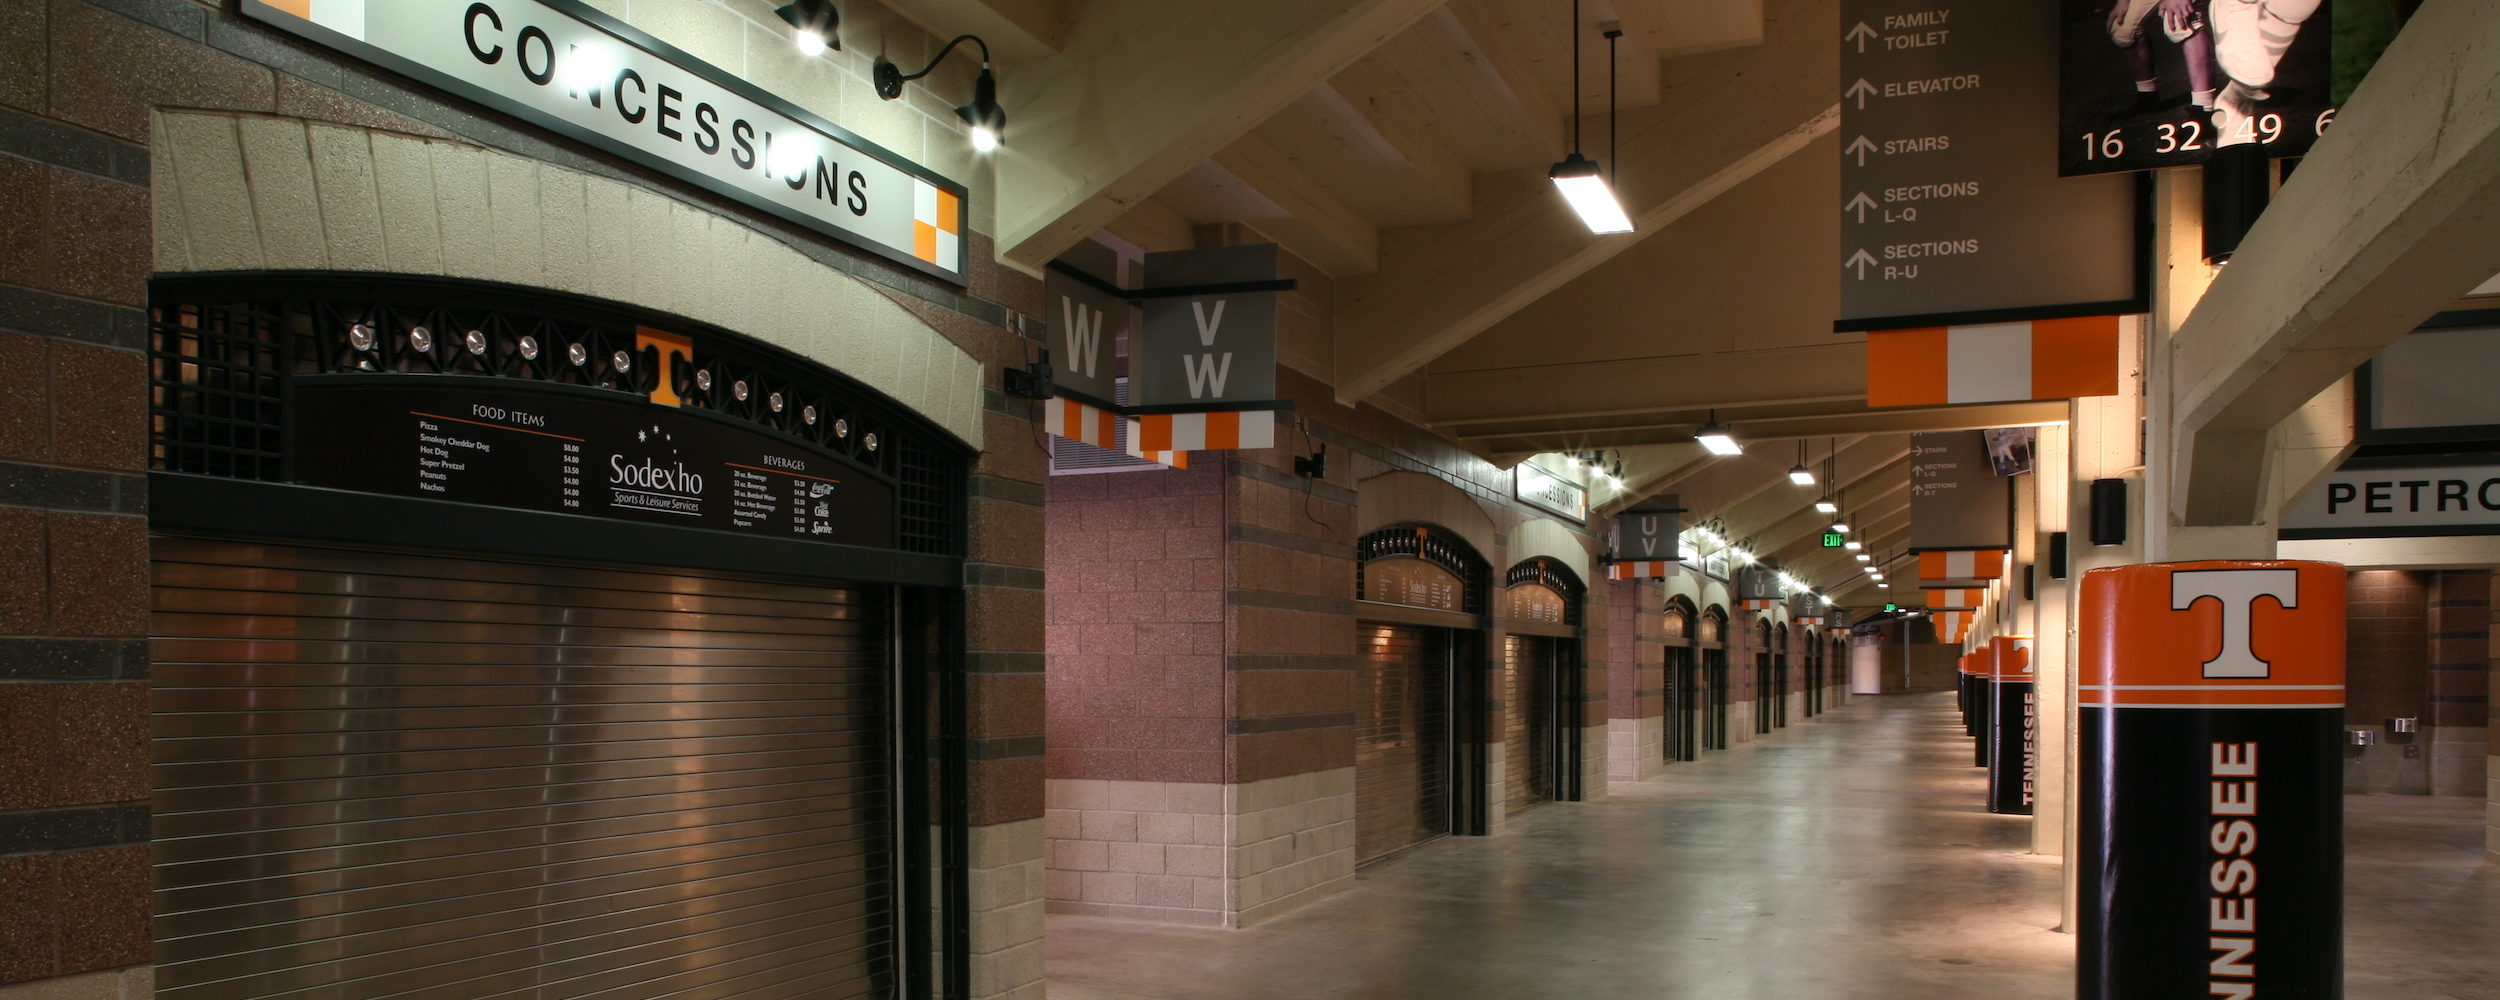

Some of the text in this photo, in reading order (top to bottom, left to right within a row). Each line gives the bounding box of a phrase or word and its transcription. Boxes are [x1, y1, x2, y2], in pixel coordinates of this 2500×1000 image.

[1884, 9, 1949, 30] FAMILY
[1884, 31, 1949, 51] TOILET
[1884, 75, 1980, 97] ELEVATOR
[1884, 135, 1949, 155] STAIRS
[2082, 128, 2124, 160] 16
[2156, 120, 2201, 153] 32
[2233, 113, 2282, 145] 49
[1884, 181, 1979, 202] SECTIONS
[1884, 207, 1917, 223] L-Q
[1884, 239, 1978, 260] SECTIONS
[1884, 265, 1918, 280] R-U
[1192, 300, 1226, 346] V
[1062, 295, 1103, 379] W
[636, 325, 693, 408] T
[1183, 352, 1233, 399] W
[420, 421, 438, 431] Pizza
[473, 404, 545, 427] FOOD ITEMS
[420, 433, 580, 464] Smokey Cheddar Dog $4.00
[1924, 446, 1947, 454] STAIRS
[420, 446, 580, 475] Hot Dog $3.50
[763, 454, 805, 471] BEVERAGES
[420, 458, 580, 486] Super Pretzel $4.00
[610, 453, 703, 495] Sodexho
[747, 472, 767, 482] Beverage
[420, 470, 580, 497] Peanuts $4.00
[747, 482, 767, 492] Beverage
[420, 482, 580, 508] Nachos $4.00
[614, 491, 699, 512] Sports & Leisure Services
[753, 511, 767, 520] Candy
[756, 502, 776, 512] Beverage
[812, 521, 833, 534] Sprite
[1641, 516, 1657, 536] U
[1641, 538, 1657, 557] V
[1824, 534, 1841, 547] EXIT
[1754, 570, 1765, 583] T
[1754, 584, 1765, 597] U
[2170, 568, 2298, 679] T
